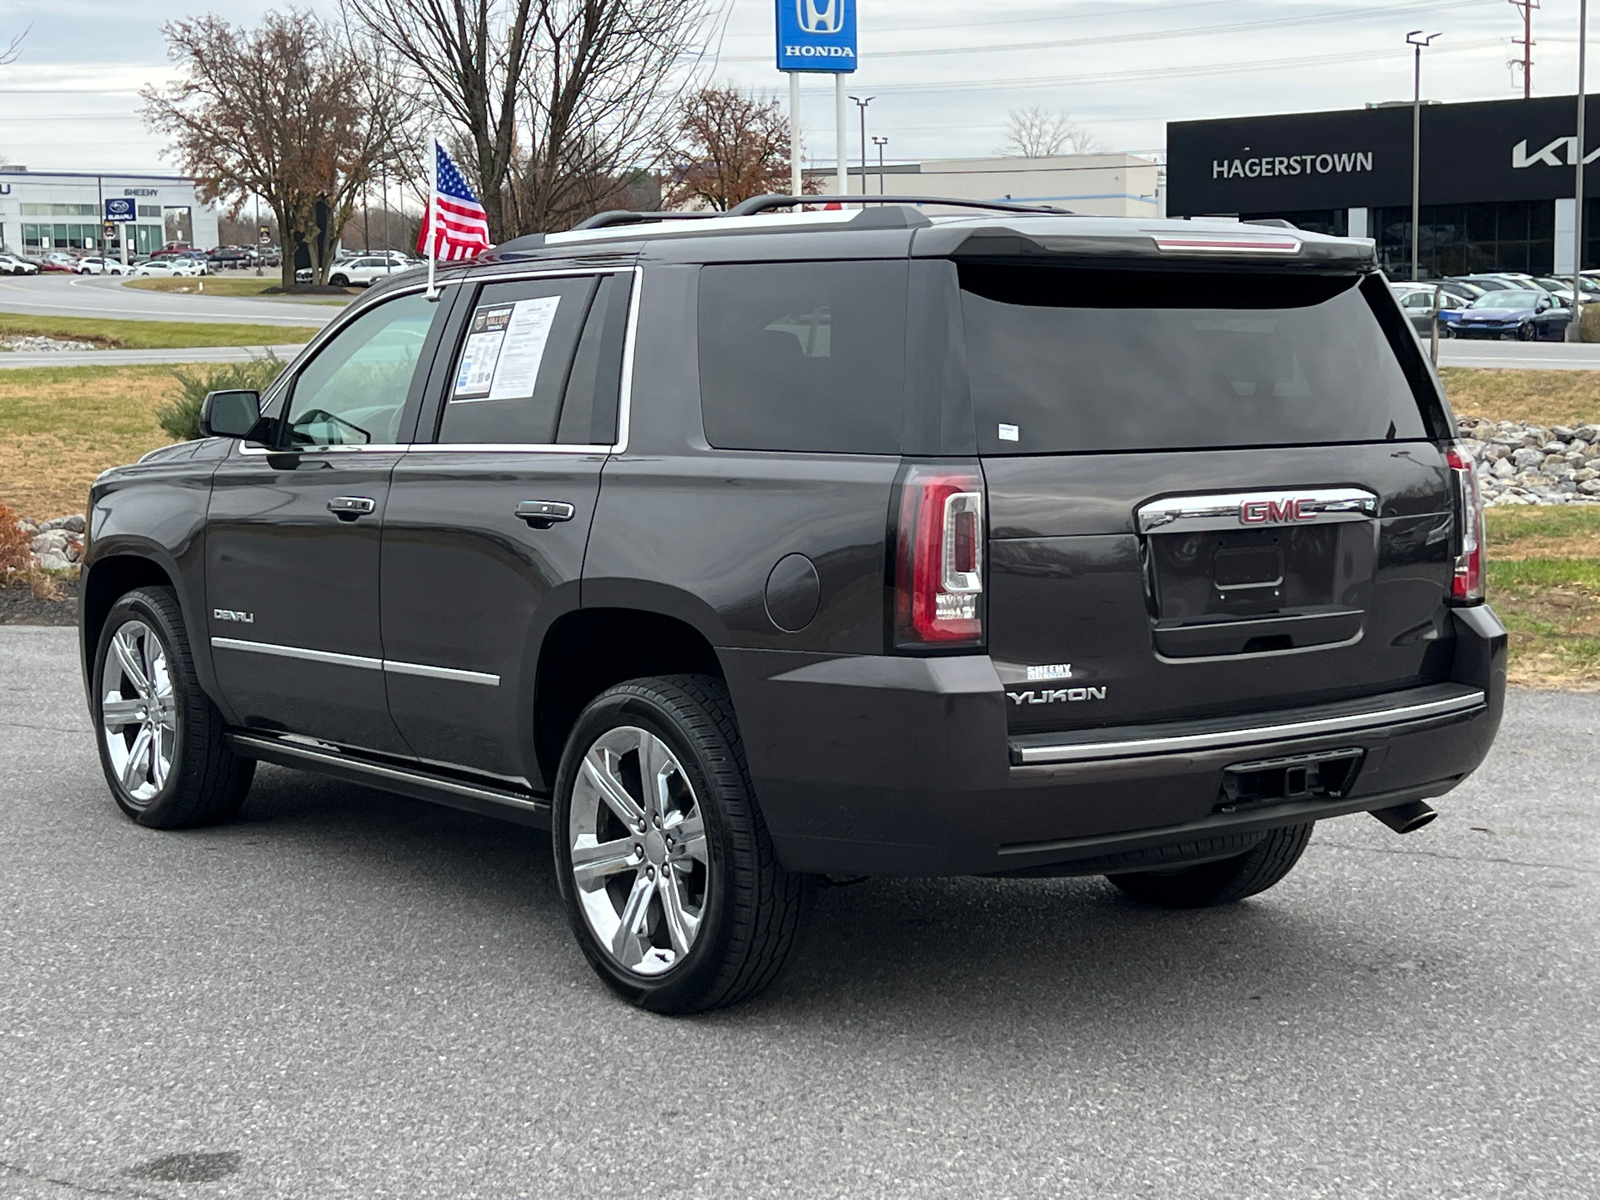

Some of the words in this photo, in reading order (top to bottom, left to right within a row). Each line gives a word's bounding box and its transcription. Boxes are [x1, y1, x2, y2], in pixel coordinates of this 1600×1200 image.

[785, 45, 855, 58] HONDA
[1212, 151, 1373, 179] HAGERSTOWN
[1241, 498, 1318, 525] GMC
[213, 608, 254, 623] DENALI
[1027, 663, 1071, 674] SHEEHY
[1006, 686, 1107, 705] YUKON
